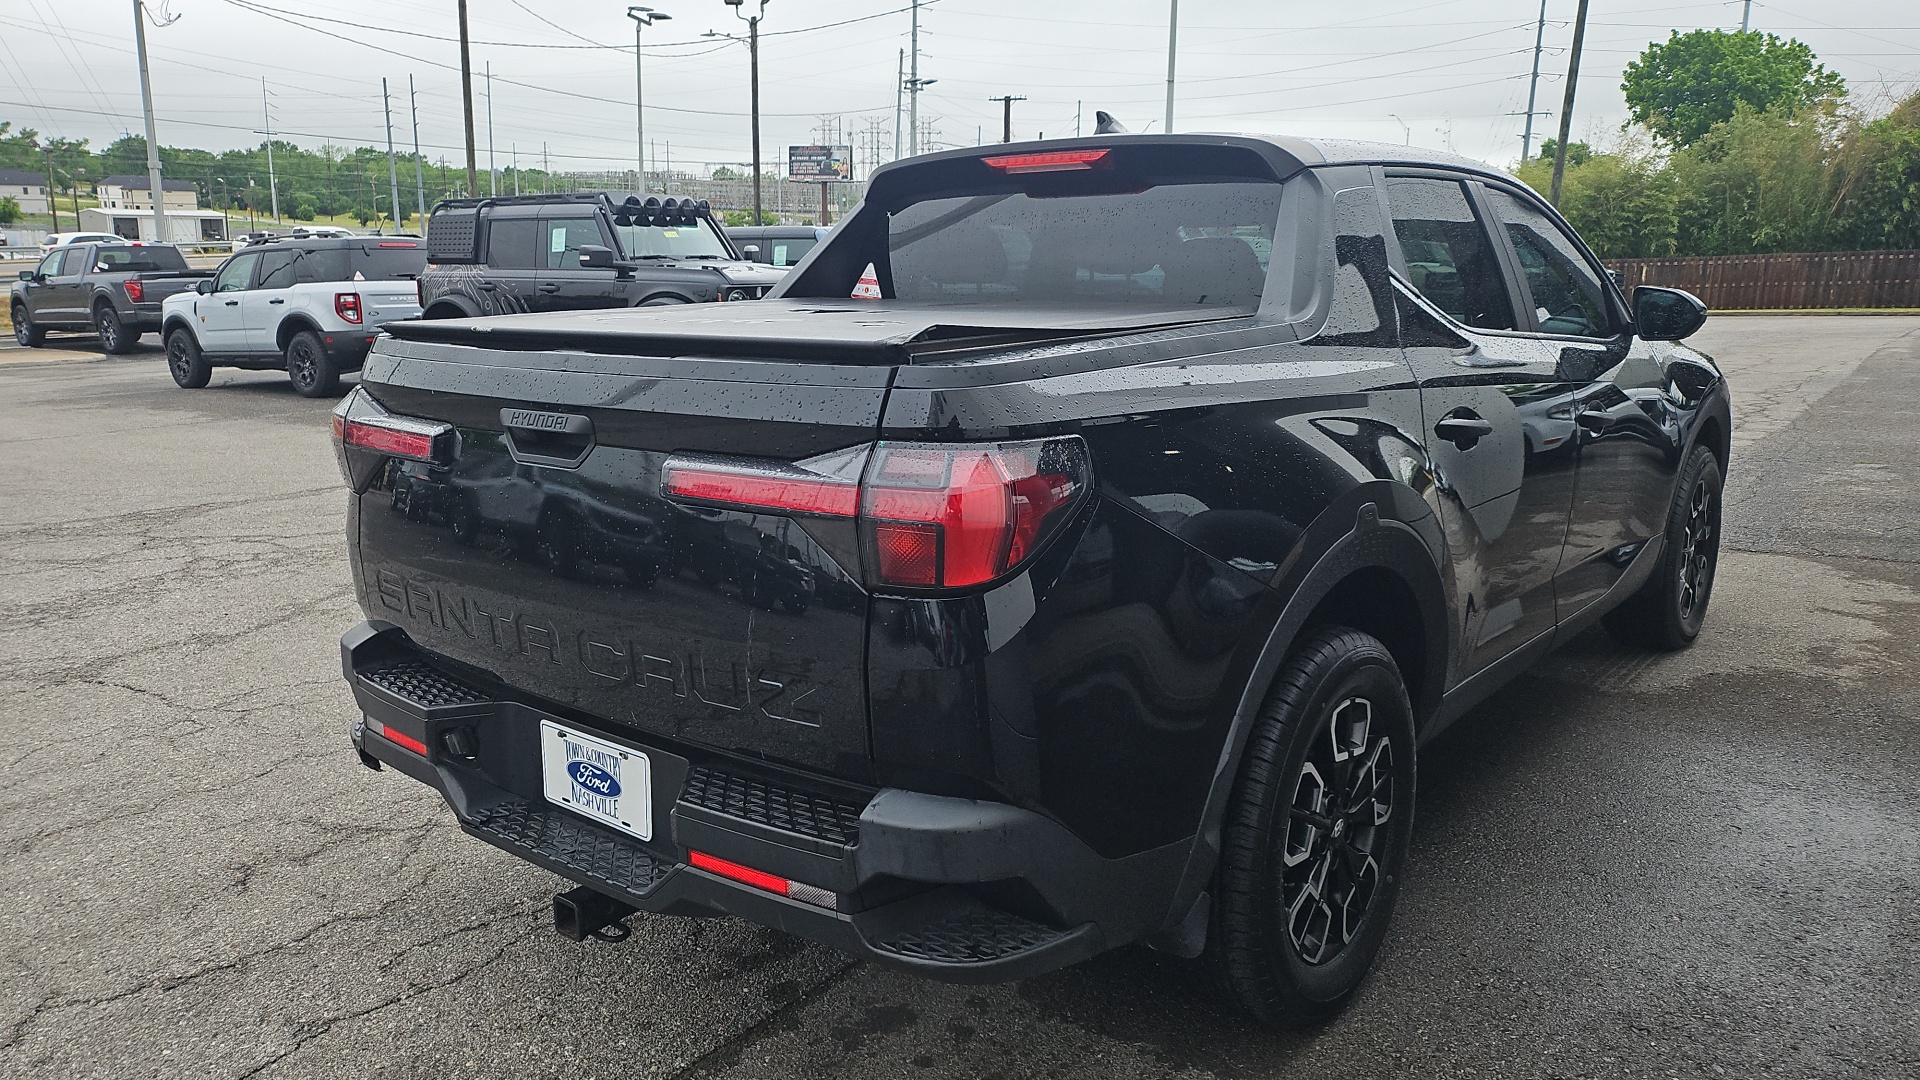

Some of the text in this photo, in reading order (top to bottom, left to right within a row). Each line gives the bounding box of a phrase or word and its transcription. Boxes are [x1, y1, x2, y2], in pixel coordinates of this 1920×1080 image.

[510, 411, 569, 430] HYUNDAI
[377, 568, 823, 728] SANTA CRUZ
[563, 739, 622, 783] TOWN & COUNTRY
[576, 763, 611, 794] Ford
[571, 780, 619, 820] NASHVILLE
